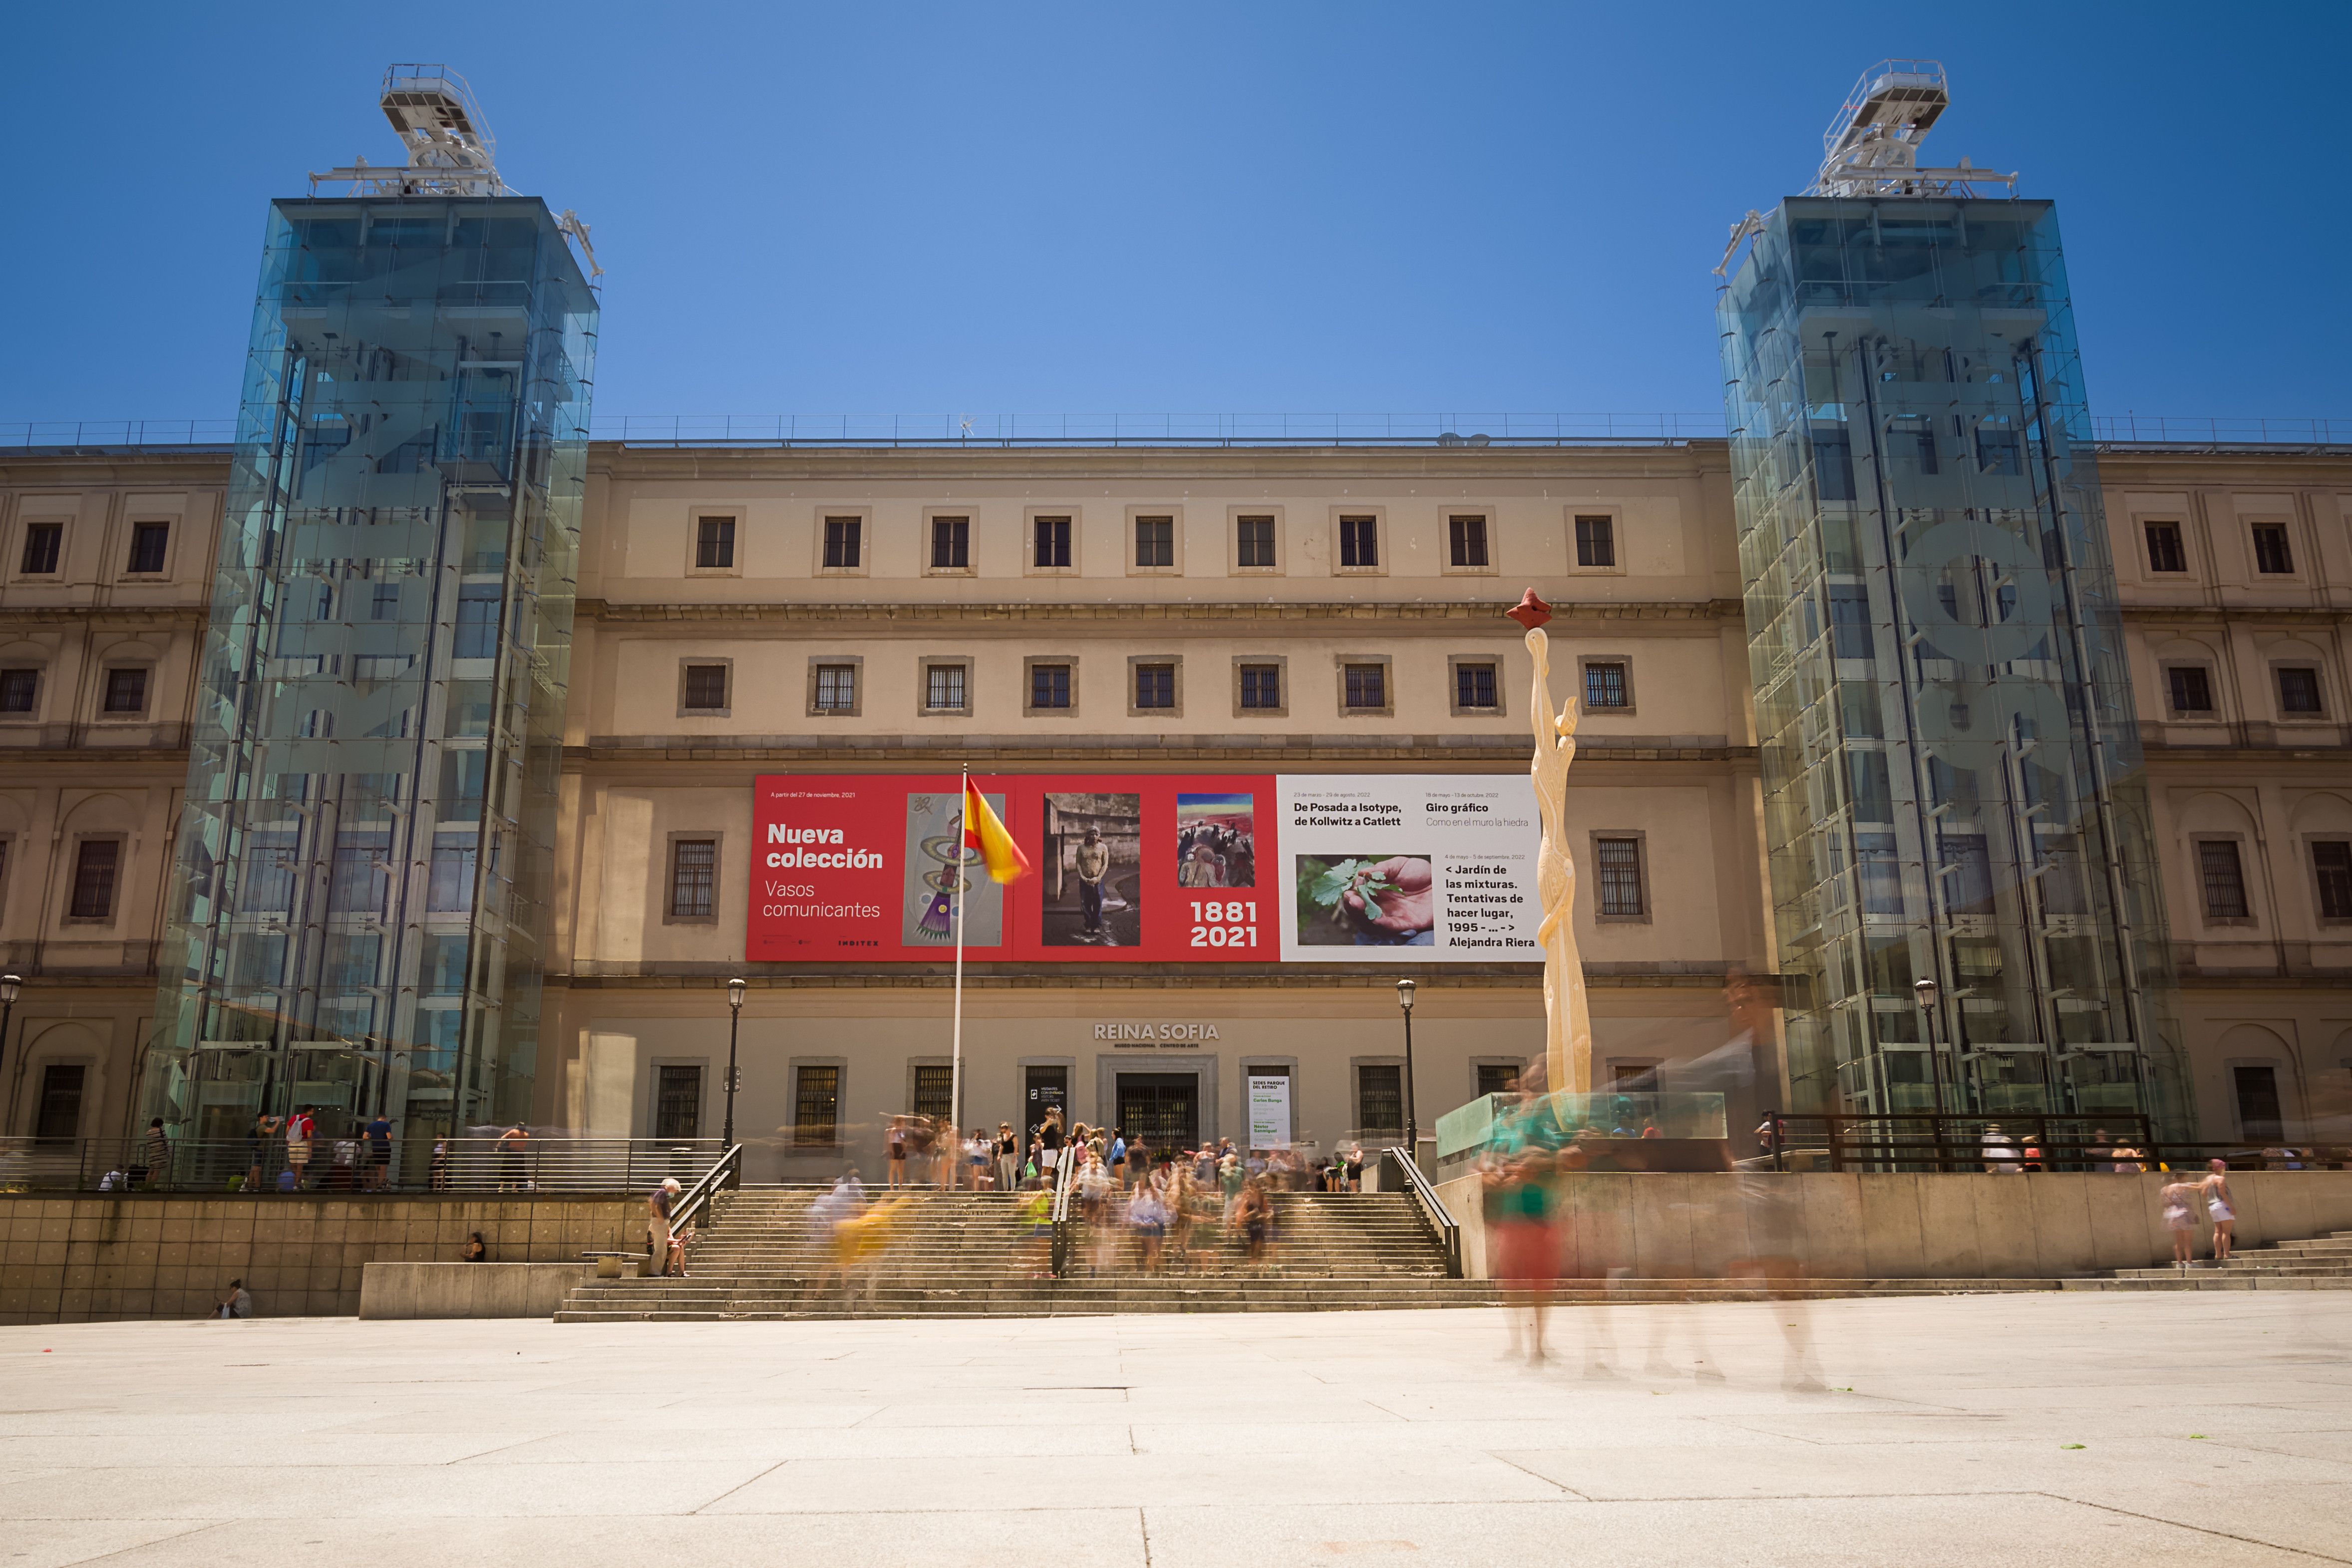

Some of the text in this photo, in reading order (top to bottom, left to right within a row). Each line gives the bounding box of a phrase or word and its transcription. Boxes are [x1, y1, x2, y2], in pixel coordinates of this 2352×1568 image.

[1294, 803, 1308, 812] De
[1310, 803, 1348, 812] Posada
[1359, 803, 1401, 814] Isotype,
[1426, 803, 1488, 814] Giro gráfico
[1295, 817, 1308, 826] de
[1310, 817, 1352, 826] Kollwitz
[1363, 817, 1401, 826] Catlett
[1426, 818, 1451, 826] Como
[1464, 818, 1471, 826] el
[1495, 818, 1502, 826] la
[1503, 818, 1528, 826] hiedra
[767, 824, 843, 844] Nueva
[766, 847, 883, 869] colección
[1455, 865, 1490, 874] Jardín
[1493, 865, 1507, 874] de
[765, 880, 815, 897] Vasos
[1446, 879, 1517, 889] las mixturas.
[1447, 894, 1523, 903] Tentativas de
[763, 902, 880, 918] comunicantes
[1190, 902, 1257, 923] 1881
[1447, 908, 1513, 920] hacer lugar,
[1448, 923, 1478, 932] 1995
[1191, 926, 1257, 947] 2021
[1449, 938, 1535, 948] Alejandra Riera
[1094, 1023, 1220, 1040] REINA SOFIA
